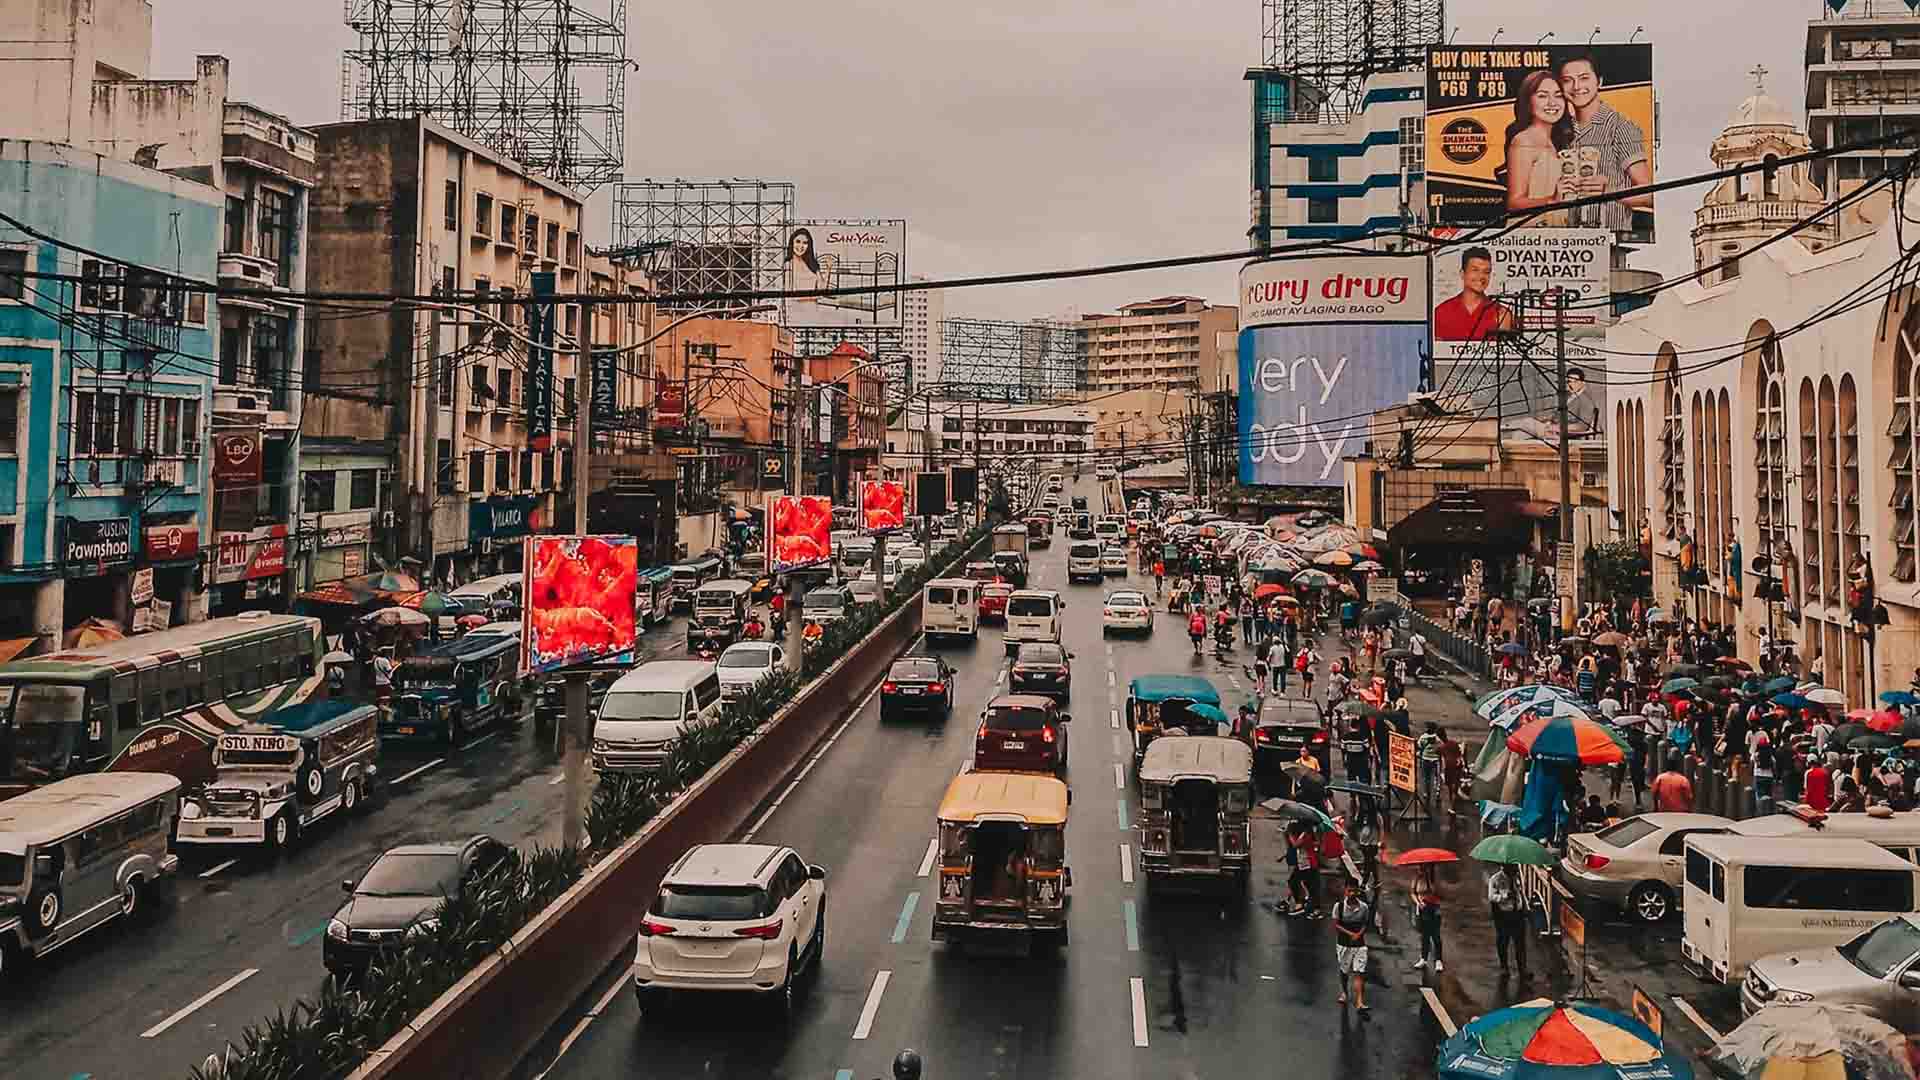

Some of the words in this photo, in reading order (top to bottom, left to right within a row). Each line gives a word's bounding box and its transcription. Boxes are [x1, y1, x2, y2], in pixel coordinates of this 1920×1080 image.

[1432, 51, 1457, 68] BUY
[1461, 51, 1487, 68] ONE
[1488, 51, 1521, 68] TAKE
[1523, 51, 1550, 68] ONE
[1449, 145, 1480, 153] SHACK
[1545, 238, 1559, 246] na
[1561, 235, 1607, 249] gamot?
[1496, 250, 1547, 263] DIYAN
[1551, 249, 1594, 263] TAYO
[1507, 265, 1529, 278] SA
[1531, 264, 1586, 278] TAPAT!
[1321, 273, 1409, 304] drug
[1288, 306, 1302, 315] AY
[1304, 305, 1346, 315] LAGING
[1349, 304, 1385, 314] BAGO
[226, 445, 251, 455] LBC
[68, 538, 128, 561] Pawnshop
[225, 736, 249, 749] STO.
